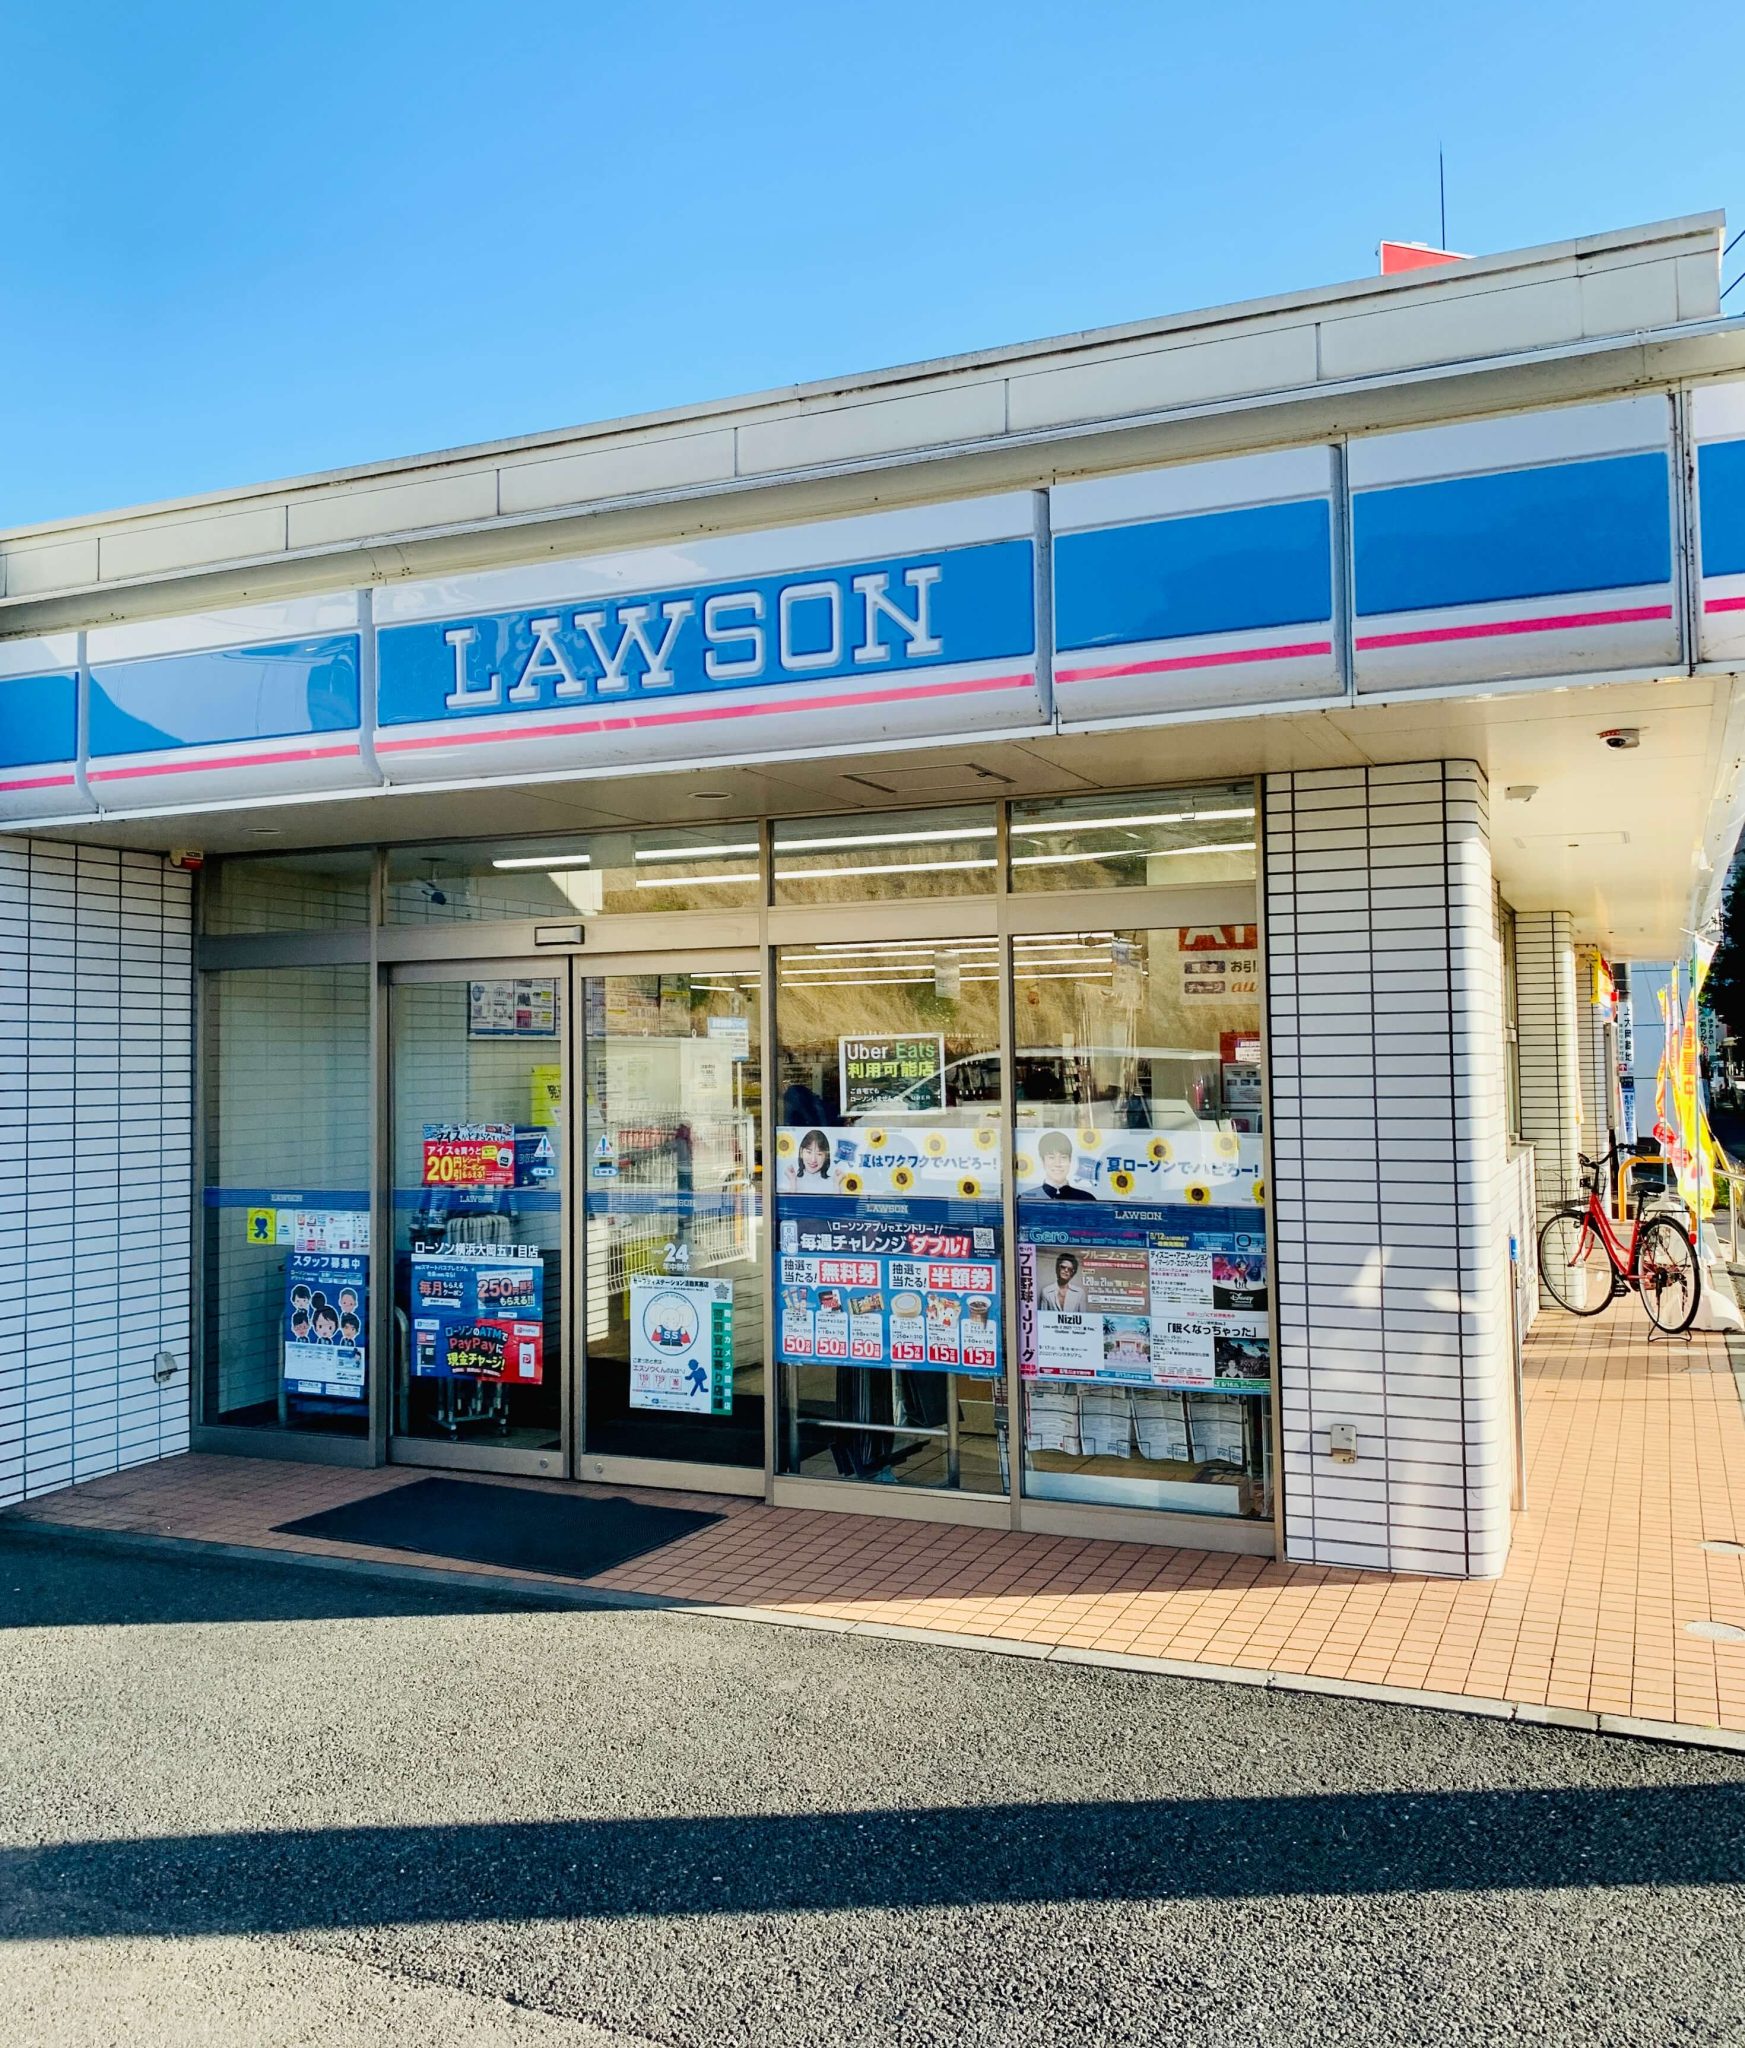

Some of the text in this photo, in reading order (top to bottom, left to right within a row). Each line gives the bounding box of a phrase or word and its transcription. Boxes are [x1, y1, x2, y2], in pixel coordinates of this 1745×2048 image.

[445, 564, 942, 709] LAWSON
[847, 1041, 935, 1060] Uber Eats
[847, 1060, 935, 1079] 利用可能店
[865, 1204, 909, 1214] LAWSON
[1114, 1210, 1162, 1221] LAWSON
[1029, 1227, 1069, 1243] Gero
[415, 1241, 540, 1258] ローソン横浜大岡五丁目店
[663, 1243, 690, 1263] 24
[292, 1255, 361, 1270] スタッフ募集中
[784, 1259, 812, 1271] 抽選で
[892, 1263, 922, 1276] 抽選で
[784, 1272, 817, 1284] 当たる!
[820, 1261, 877, 1285] 無料券
[930, 1266, 992, 1291] 半額券
[419, 1280, 442, 1297] 毎月
[892, 1275, 927, 1289] 当たる!
[1057, 1314, 1082, 1325] NiziU
[445, 1325, 509, 1342] ローソンのATMで
[663, 1330, 679, 1340] SS
[1167, 1322, 1257, 1338] 「眠くなっちゃった」
[449, 1337, 504, 1354] PayPayに
[446, 1351, 506, 1371] 現金チャージ!
